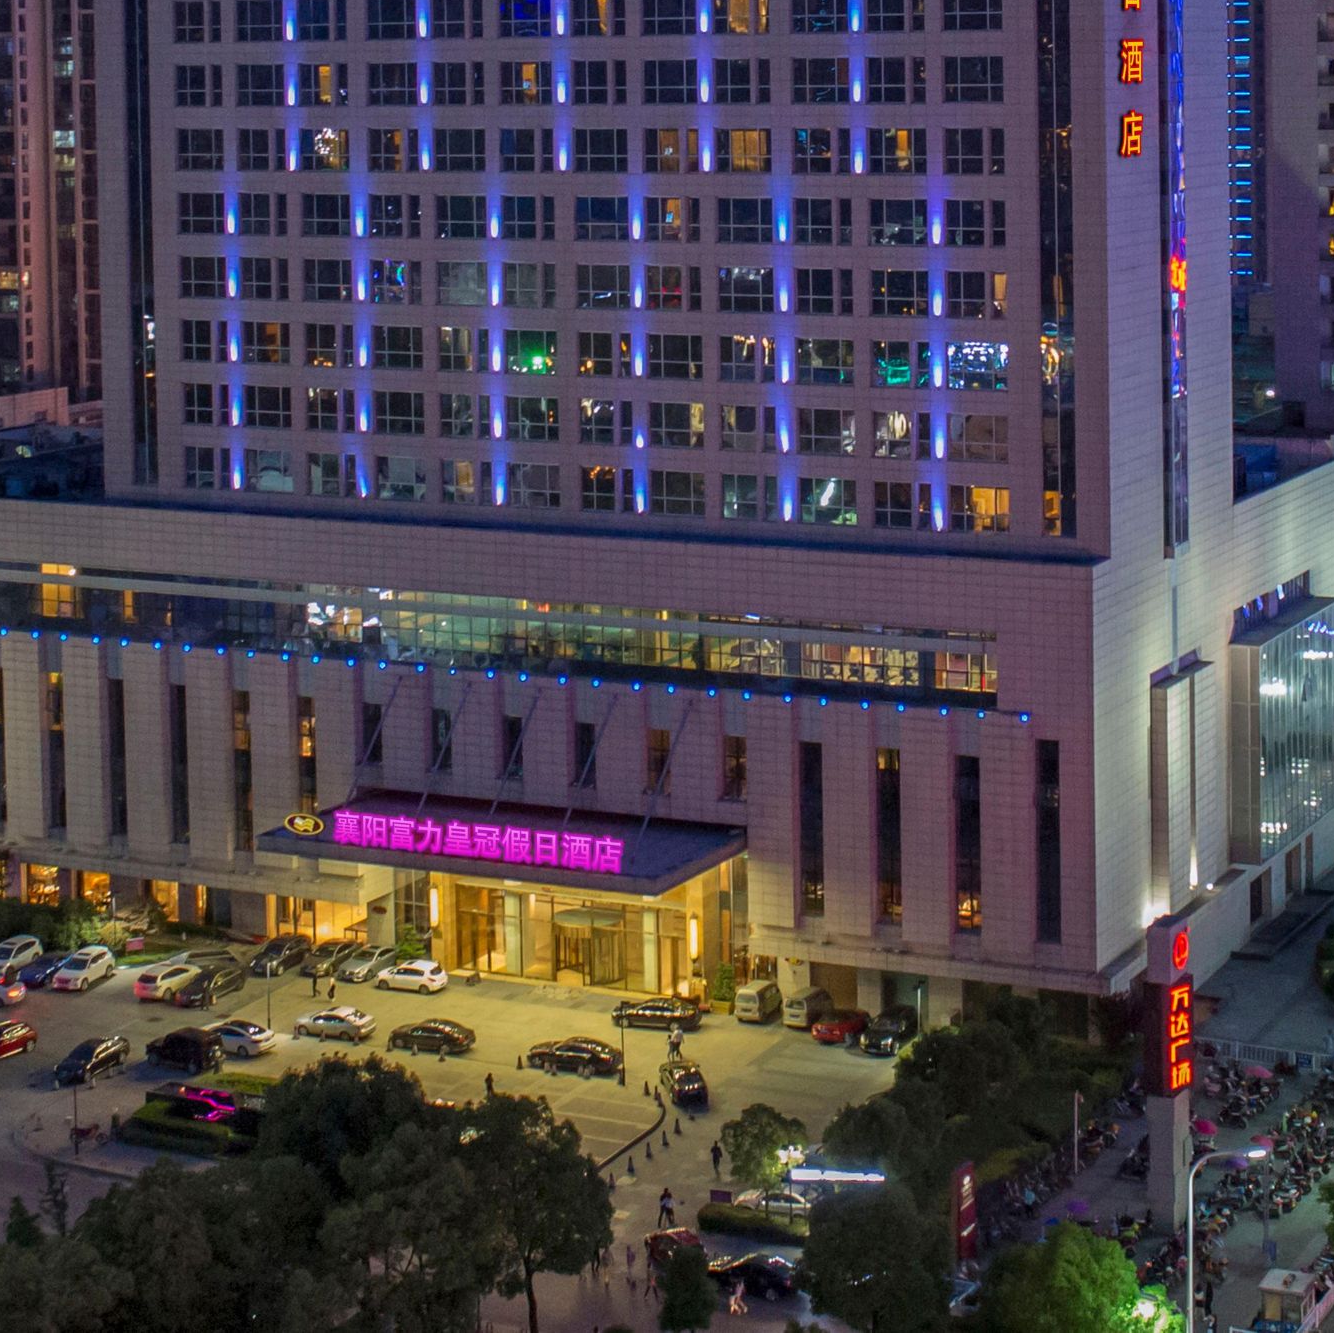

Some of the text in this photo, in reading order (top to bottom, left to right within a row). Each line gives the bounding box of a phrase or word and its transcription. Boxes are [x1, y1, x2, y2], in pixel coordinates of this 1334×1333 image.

[334, 811, 623, 873] 襄阳富力皇冠假日酒店
[1170, 985, 1191, 1090] 万达广场
